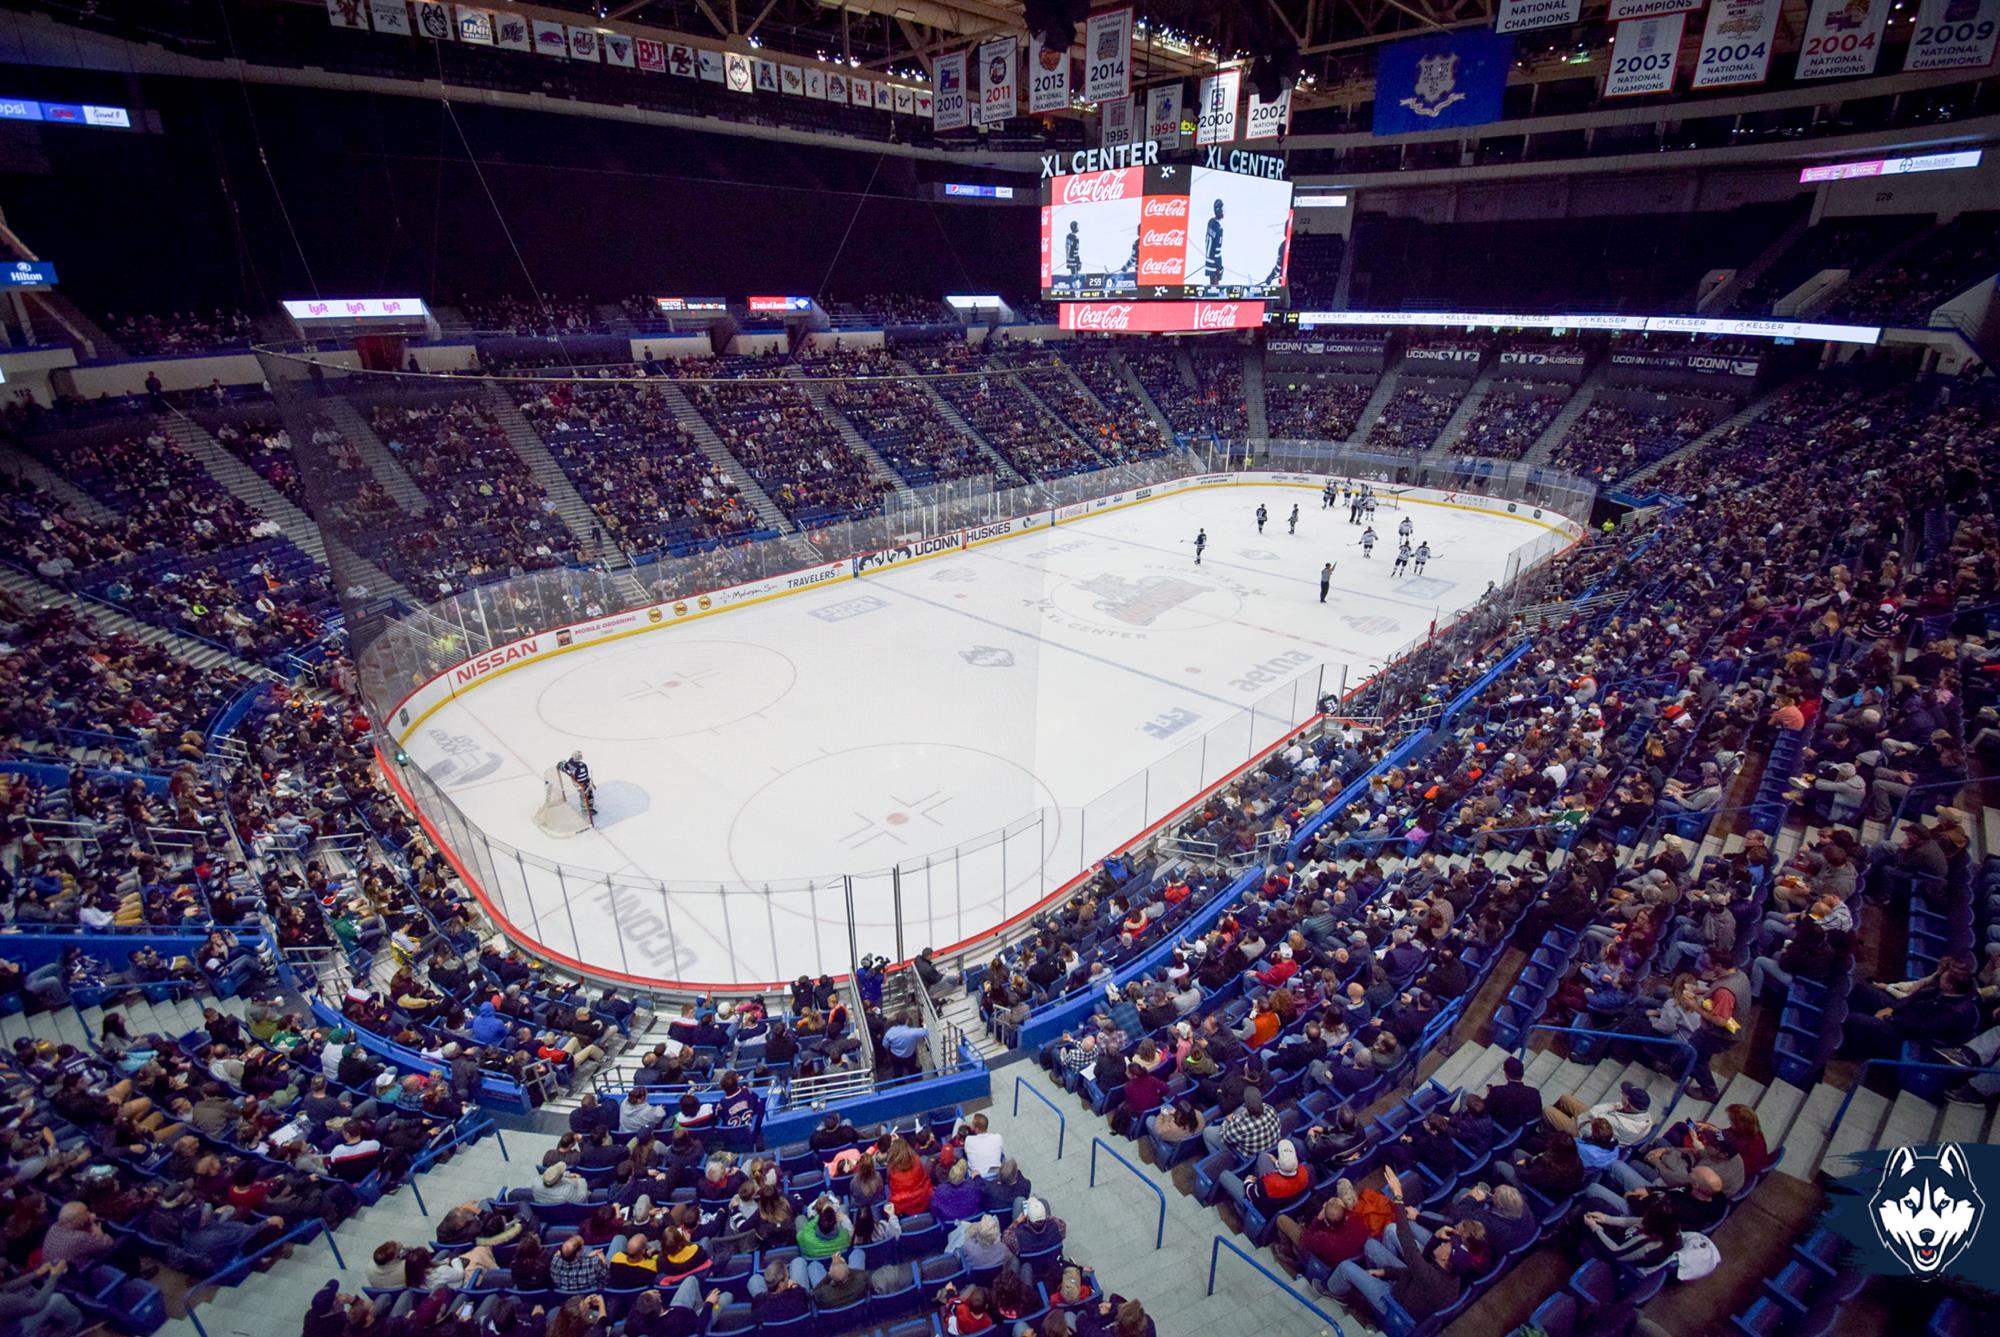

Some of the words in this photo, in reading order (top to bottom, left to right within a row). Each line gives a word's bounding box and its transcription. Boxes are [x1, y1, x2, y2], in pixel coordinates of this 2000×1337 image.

[1511, 1, 1568, 16] NATIONAL
[1619, 0, 1692, 16] CHAMPIONS
[1504, 12, 1570, 30] CHAMPIONS
[1916, 20, 1994, 46] 2009
[1805, 32, 1876, 56] 2004
[1920, 45, 1979, 56] NATIONAL
[1702, 42, 1766, 65] 2004
[1809, 55, 1864, 66] NATIONAL
[1614, 53, 1672, 74] 2003
[1706, 63, 1756, 74] NATIONAL
[1912, 55, 1982, 69] CHAMPIONS
[1090, 61, 1125, 82] 2014
[1803, 64, 1866, 77] CHAMPIONS
[1034, 73, 1064, 92] 2013
[1616, 73, 1662, 83] NATIONAL
[1700, 72, 1758, 85] CHAMPIONS
[1091, 81, 1123, 91] NATIONAL
[1611, 82, 1664, 94] CHAMPIONS
[986, 86, 1011, 103] 2011
[1035, 92, 1062, 101] NATIONAL
[1090, 90, 1124, 101] CHAMPIONS
[937, 96, 963, 112] 2010
[986, 103, 1010, 112] NATIONAL
[1033, 100, 1064, 111] CHAMPIONS
[938, 111, 961, 120] NATIONAL
[984, 111, 1013, 121] CHAMPIONS
[1200, 112, 1234, 128] 2000
[1252, 105, 1287, 121] 2002
[937, 119, 963, 128] CHAMPIONS
[1151, 122, 1176, 136] 1999
[1254, 120, 1279, 129] NATIONA
[1105, 129, 1129, 142] 1995
[1250, 128, 1278, 137] CHAMPIO
[1041, 155, 1066, 178] XL
[1072, 140, 1159, 174] CENTER
[1205, 145, 1226, 170] XL
[1230, 149, 1285, 181] CENTER
[1064, 167, 1128, 205] Coca-Cola
[1145, 199, 1188, 217] Coca-Cola
[1143, 228, 1186, 247] Coca-Cola
[1141, 257, 1184, 275] Coca-Cola
[11, 271, 43, 281] Hilton
[308, 303, 328, 316] lyft
[346, 302, 365, 315] lyft
[382, 301, 400, 314] lyft
[1077, 303, 1133, 329] Coca-Cola
[1200, 303, 1239, 328] Coca-Cola
[1590, 316, 1627, 324] KELSER
[1668, 319, 1706, 327] KELSER
[1746, 322, 1784, 330] KELSER
[1267, 342, 1302, 351] UCONN
[1326, 345, 1353, 353] UCONN
[1406, 350, 1438, 359] UCONN
[1545, 355, 1585, 365] HUSKIES
[1612, 354, 1646, 365] UCONN
[1687, 356, 1730, 369] UCONN
[915, 534, 959, 556] UCONN
[966, 522, 1011, 543] HUSKIES
[787, 569, 836, 589] TRAVELERS
[574, 623, 601, 636] MOBILE
[602, 615, 636, 629] ORDERING
[456, 639, 538, 685] NISSAN
[1227, 649, 1315, 692] aetna
[592, 886, 699, 978] UCONN
